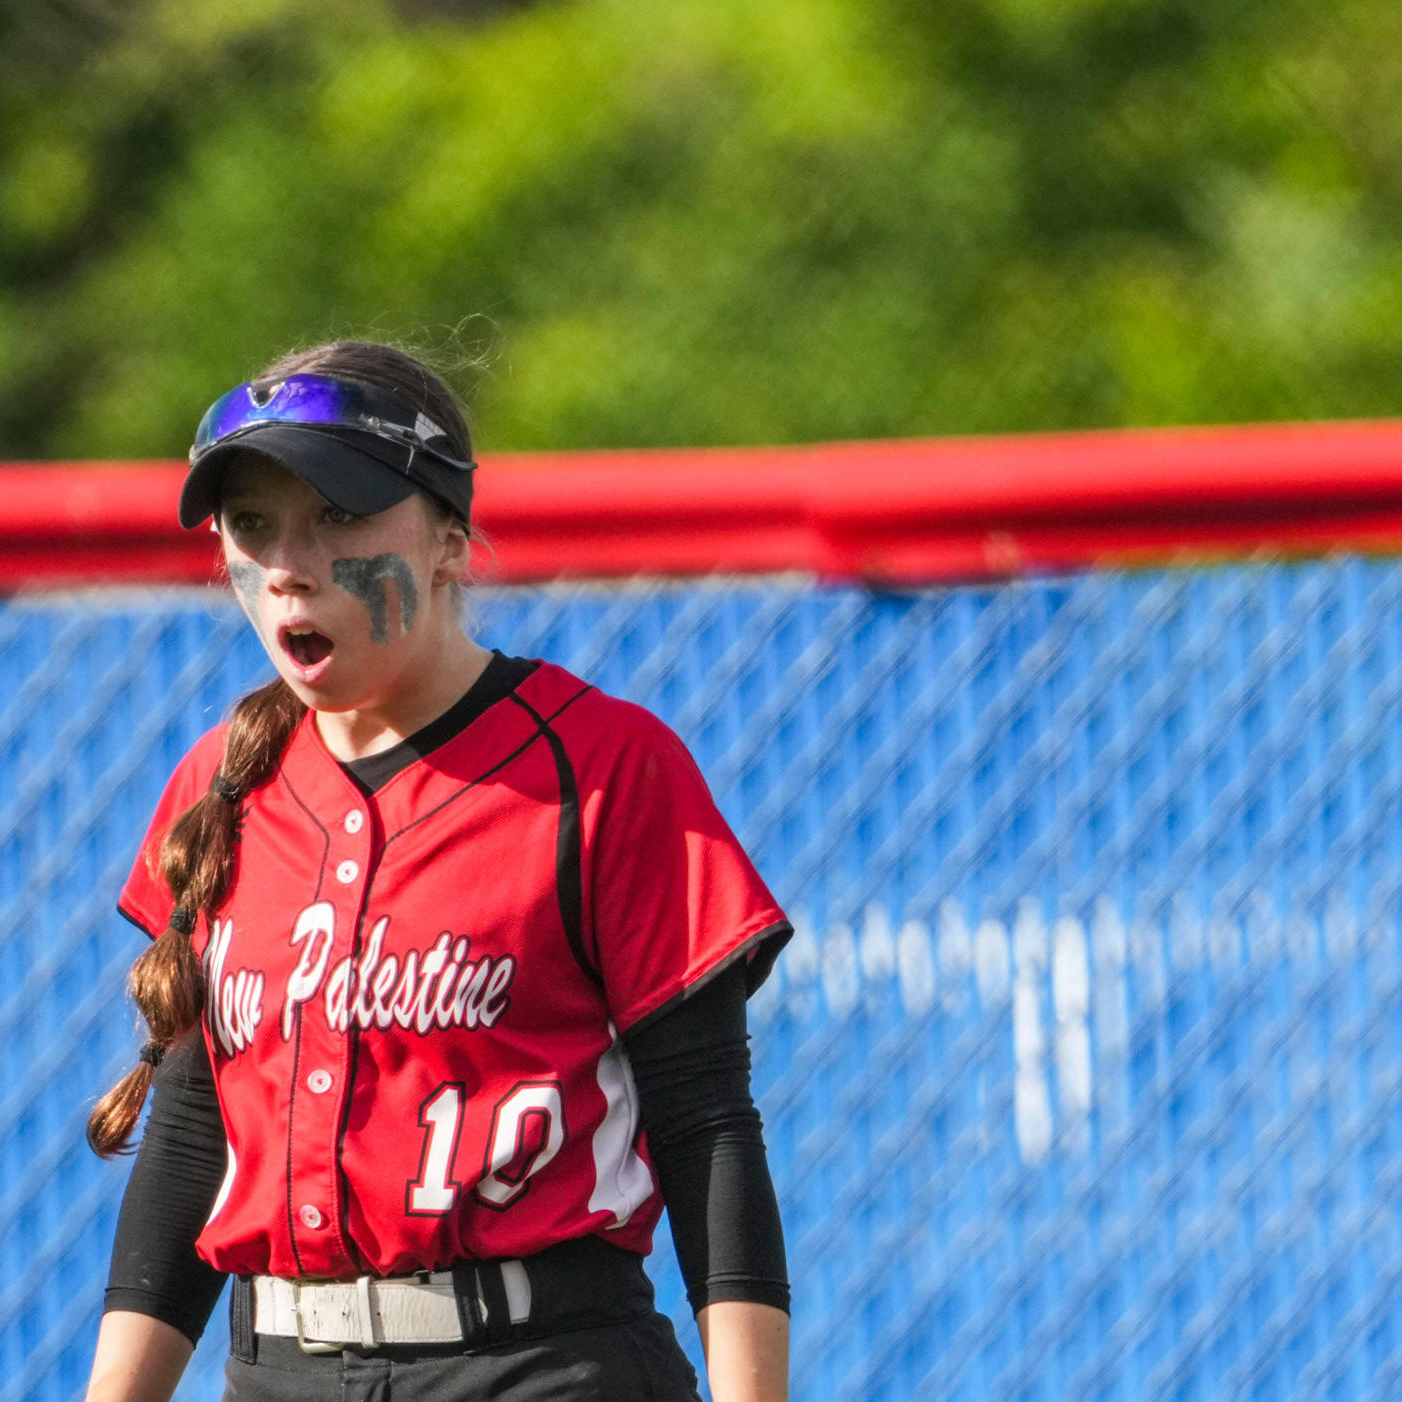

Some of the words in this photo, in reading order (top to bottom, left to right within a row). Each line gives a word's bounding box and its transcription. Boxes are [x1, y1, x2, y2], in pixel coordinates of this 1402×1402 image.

[201, 915, 266, 1060] New
[280, 900, 516, 1039] Palestine
[406, 1079, 566, 1218] 10
